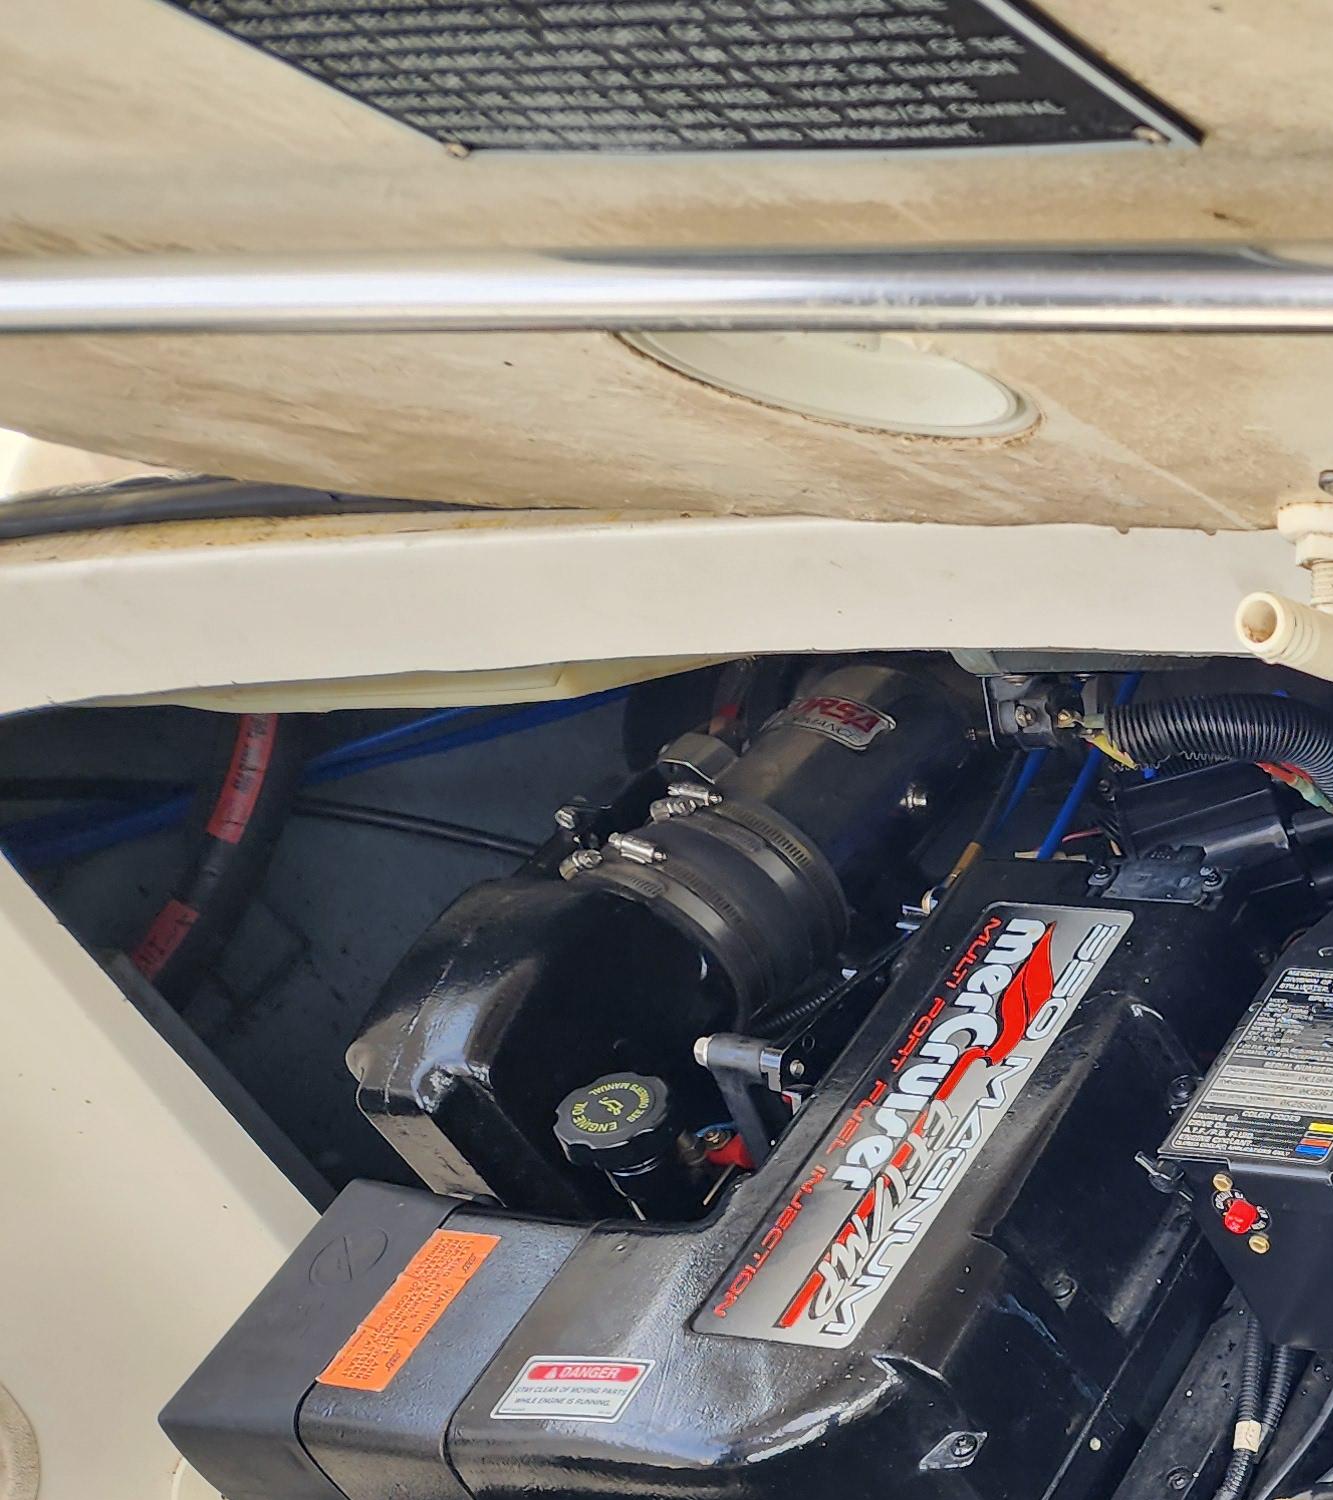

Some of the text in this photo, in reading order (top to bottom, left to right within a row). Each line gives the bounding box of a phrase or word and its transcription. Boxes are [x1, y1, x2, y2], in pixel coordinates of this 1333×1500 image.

[572, 1101, 618, 1132] ENGINE OIL
[713, 916, 1004, 1319] MULTI PORT FUEL INJECTION
[820, 924, 1120, 1335] 350 MAGNUM
[559, 1366, 621, 1379] DANGER
